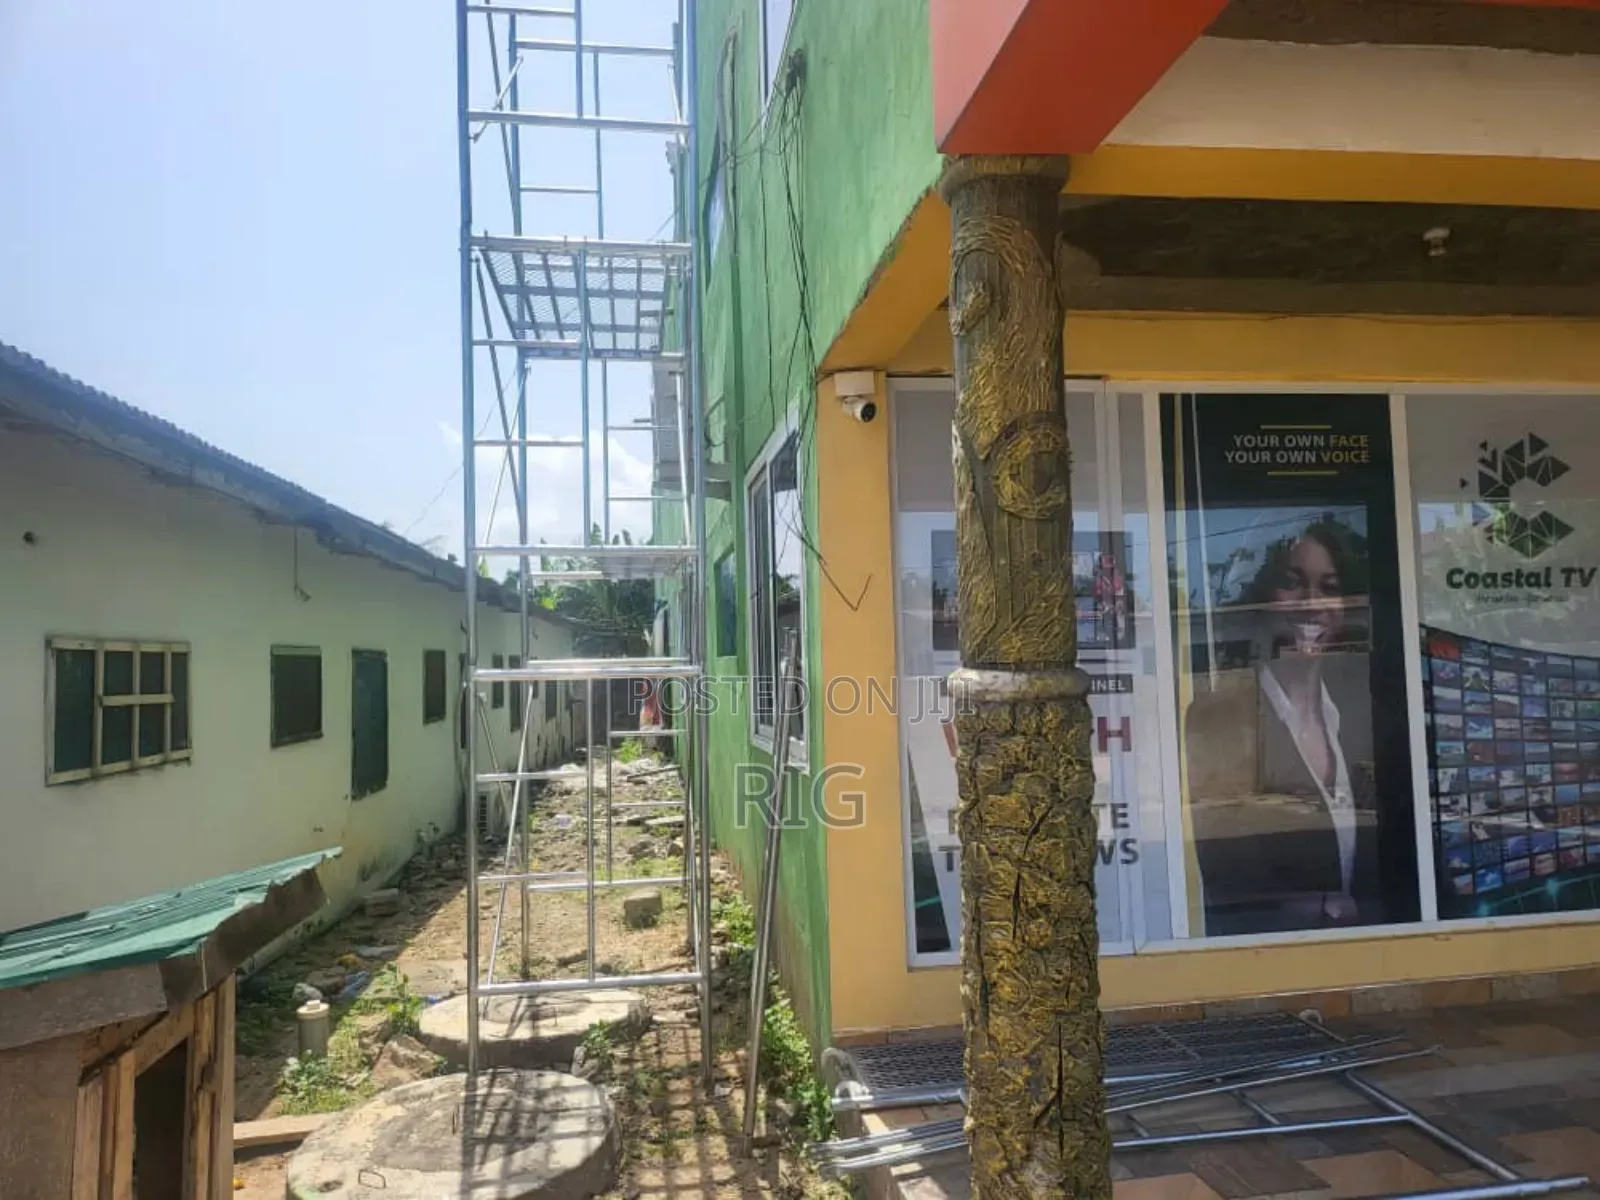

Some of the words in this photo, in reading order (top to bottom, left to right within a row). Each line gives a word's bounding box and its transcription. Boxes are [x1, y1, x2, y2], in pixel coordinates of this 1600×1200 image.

[1233, 434, 1279, 448] YOUR
[1284, 434, 1325, 448] OWN
[1329, 434, 1369, 447] FACE
[1225, 450, 1271, 464] YOUR
[1275, 450, 1316, 464] OWN
[1320, 450, 1370, 463] VOICE
[1446, 566, 1553, 589] Coastal
[1559, 566, 1598, 588] TV
